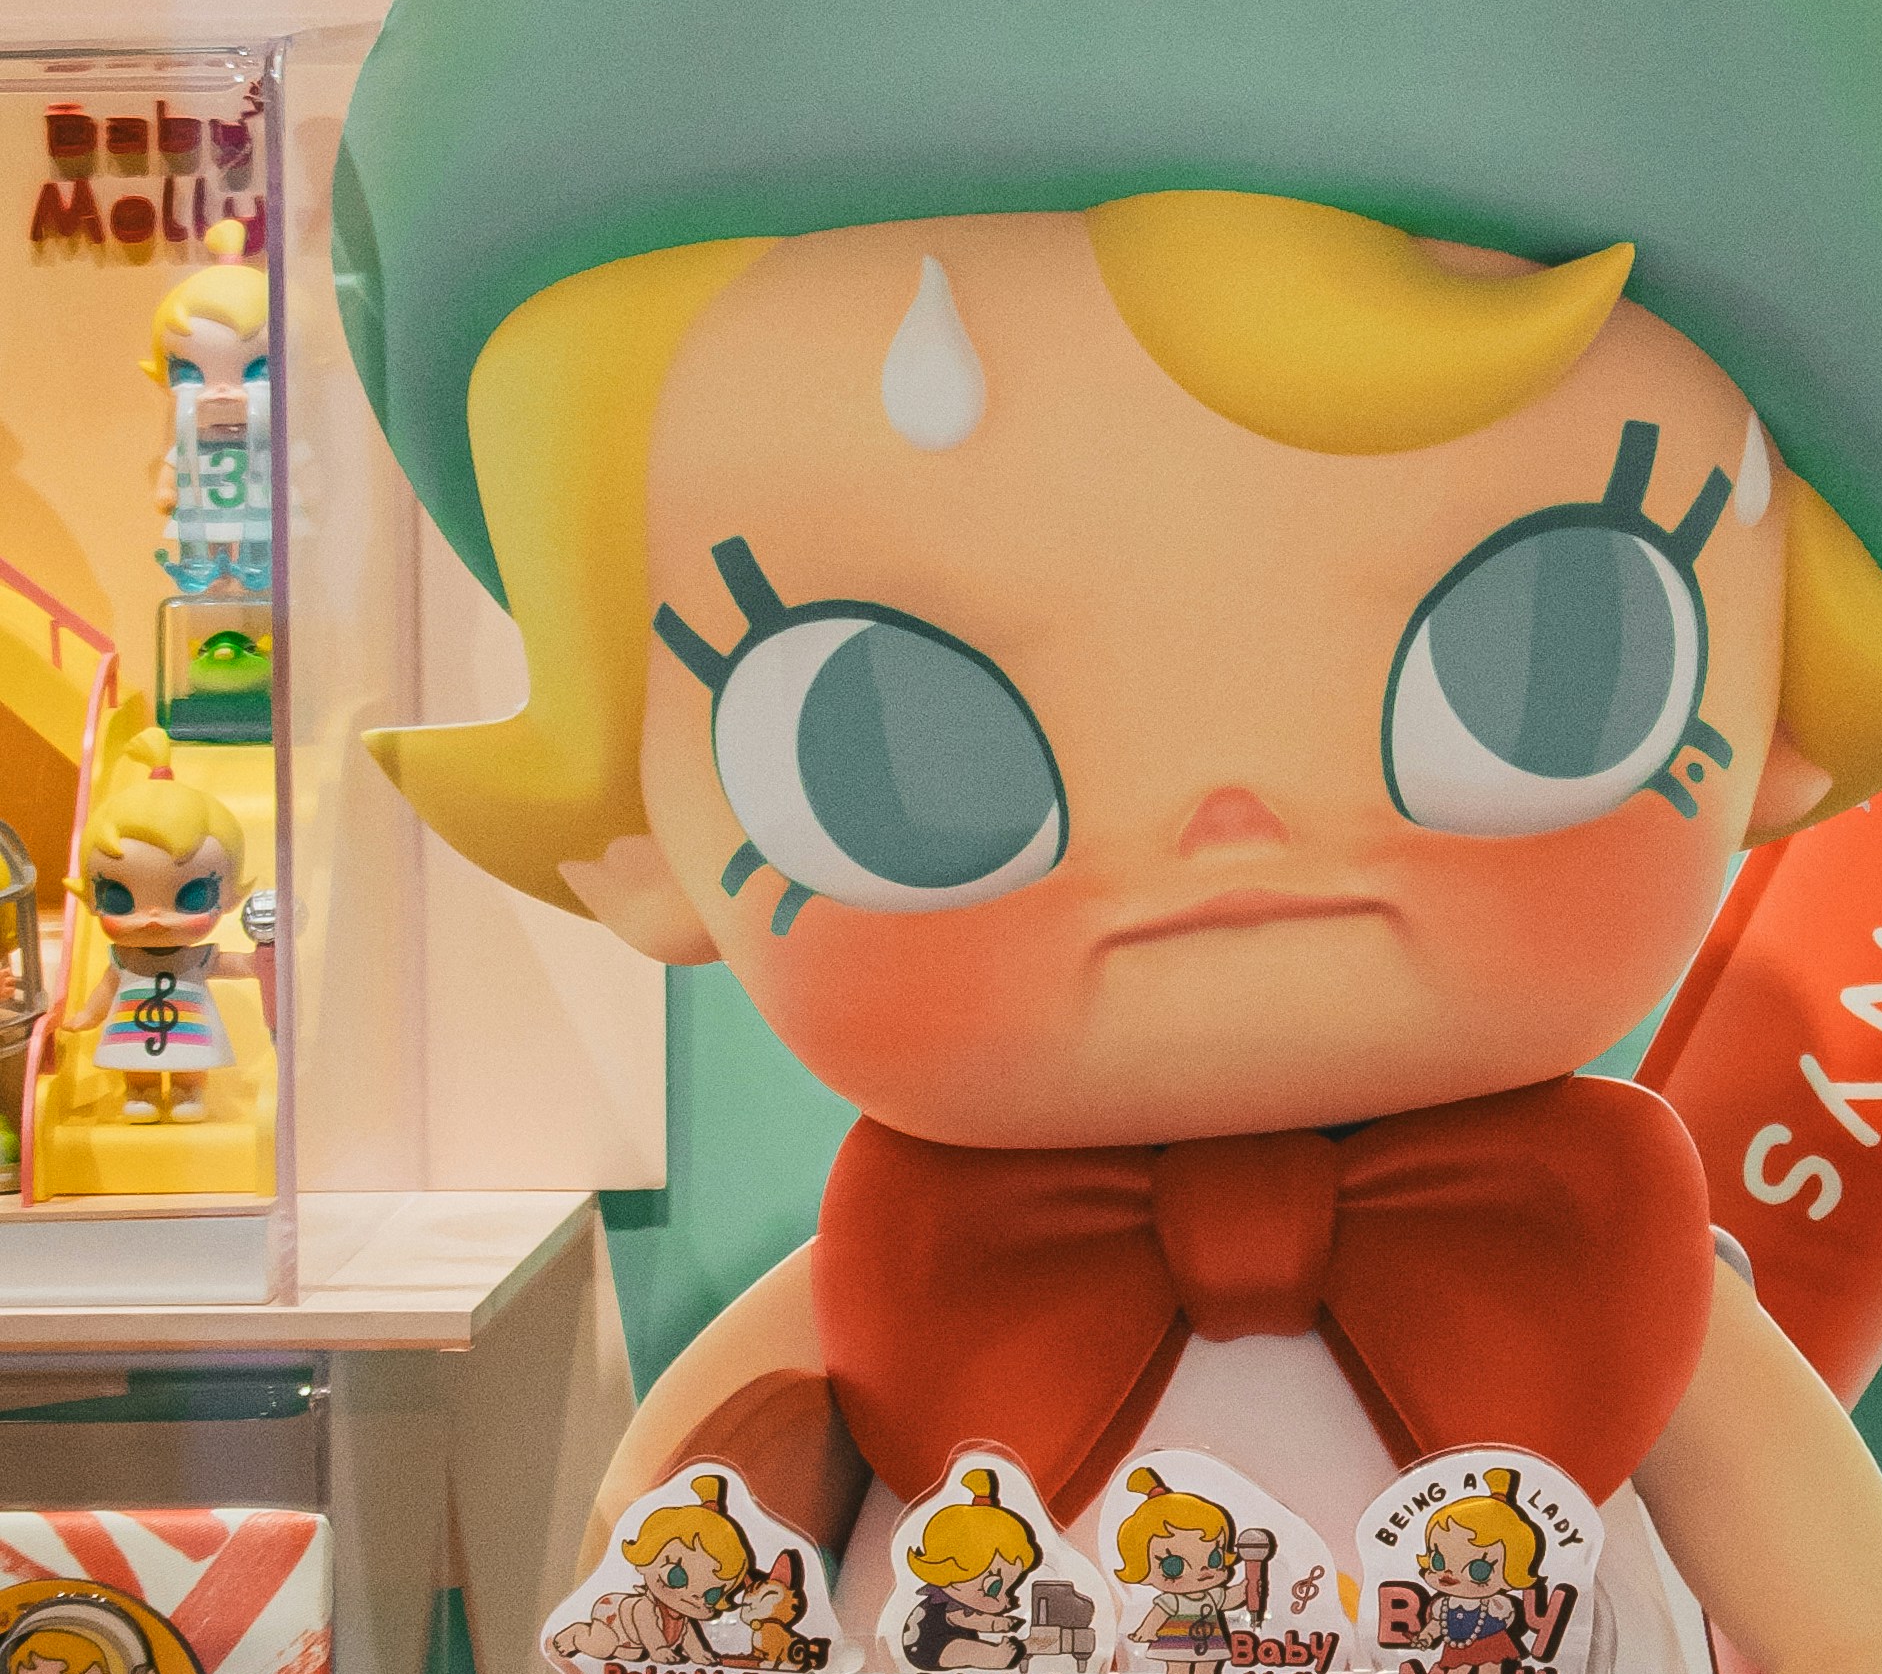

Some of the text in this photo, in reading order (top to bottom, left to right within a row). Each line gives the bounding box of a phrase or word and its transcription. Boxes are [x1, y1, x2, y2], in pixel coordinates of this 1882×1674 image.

[208, 448, 249, 508] 3
[1375, 1473, 1584, 1548] BEING A LADY
[1230, 1630, 1340, 1674] Baby
